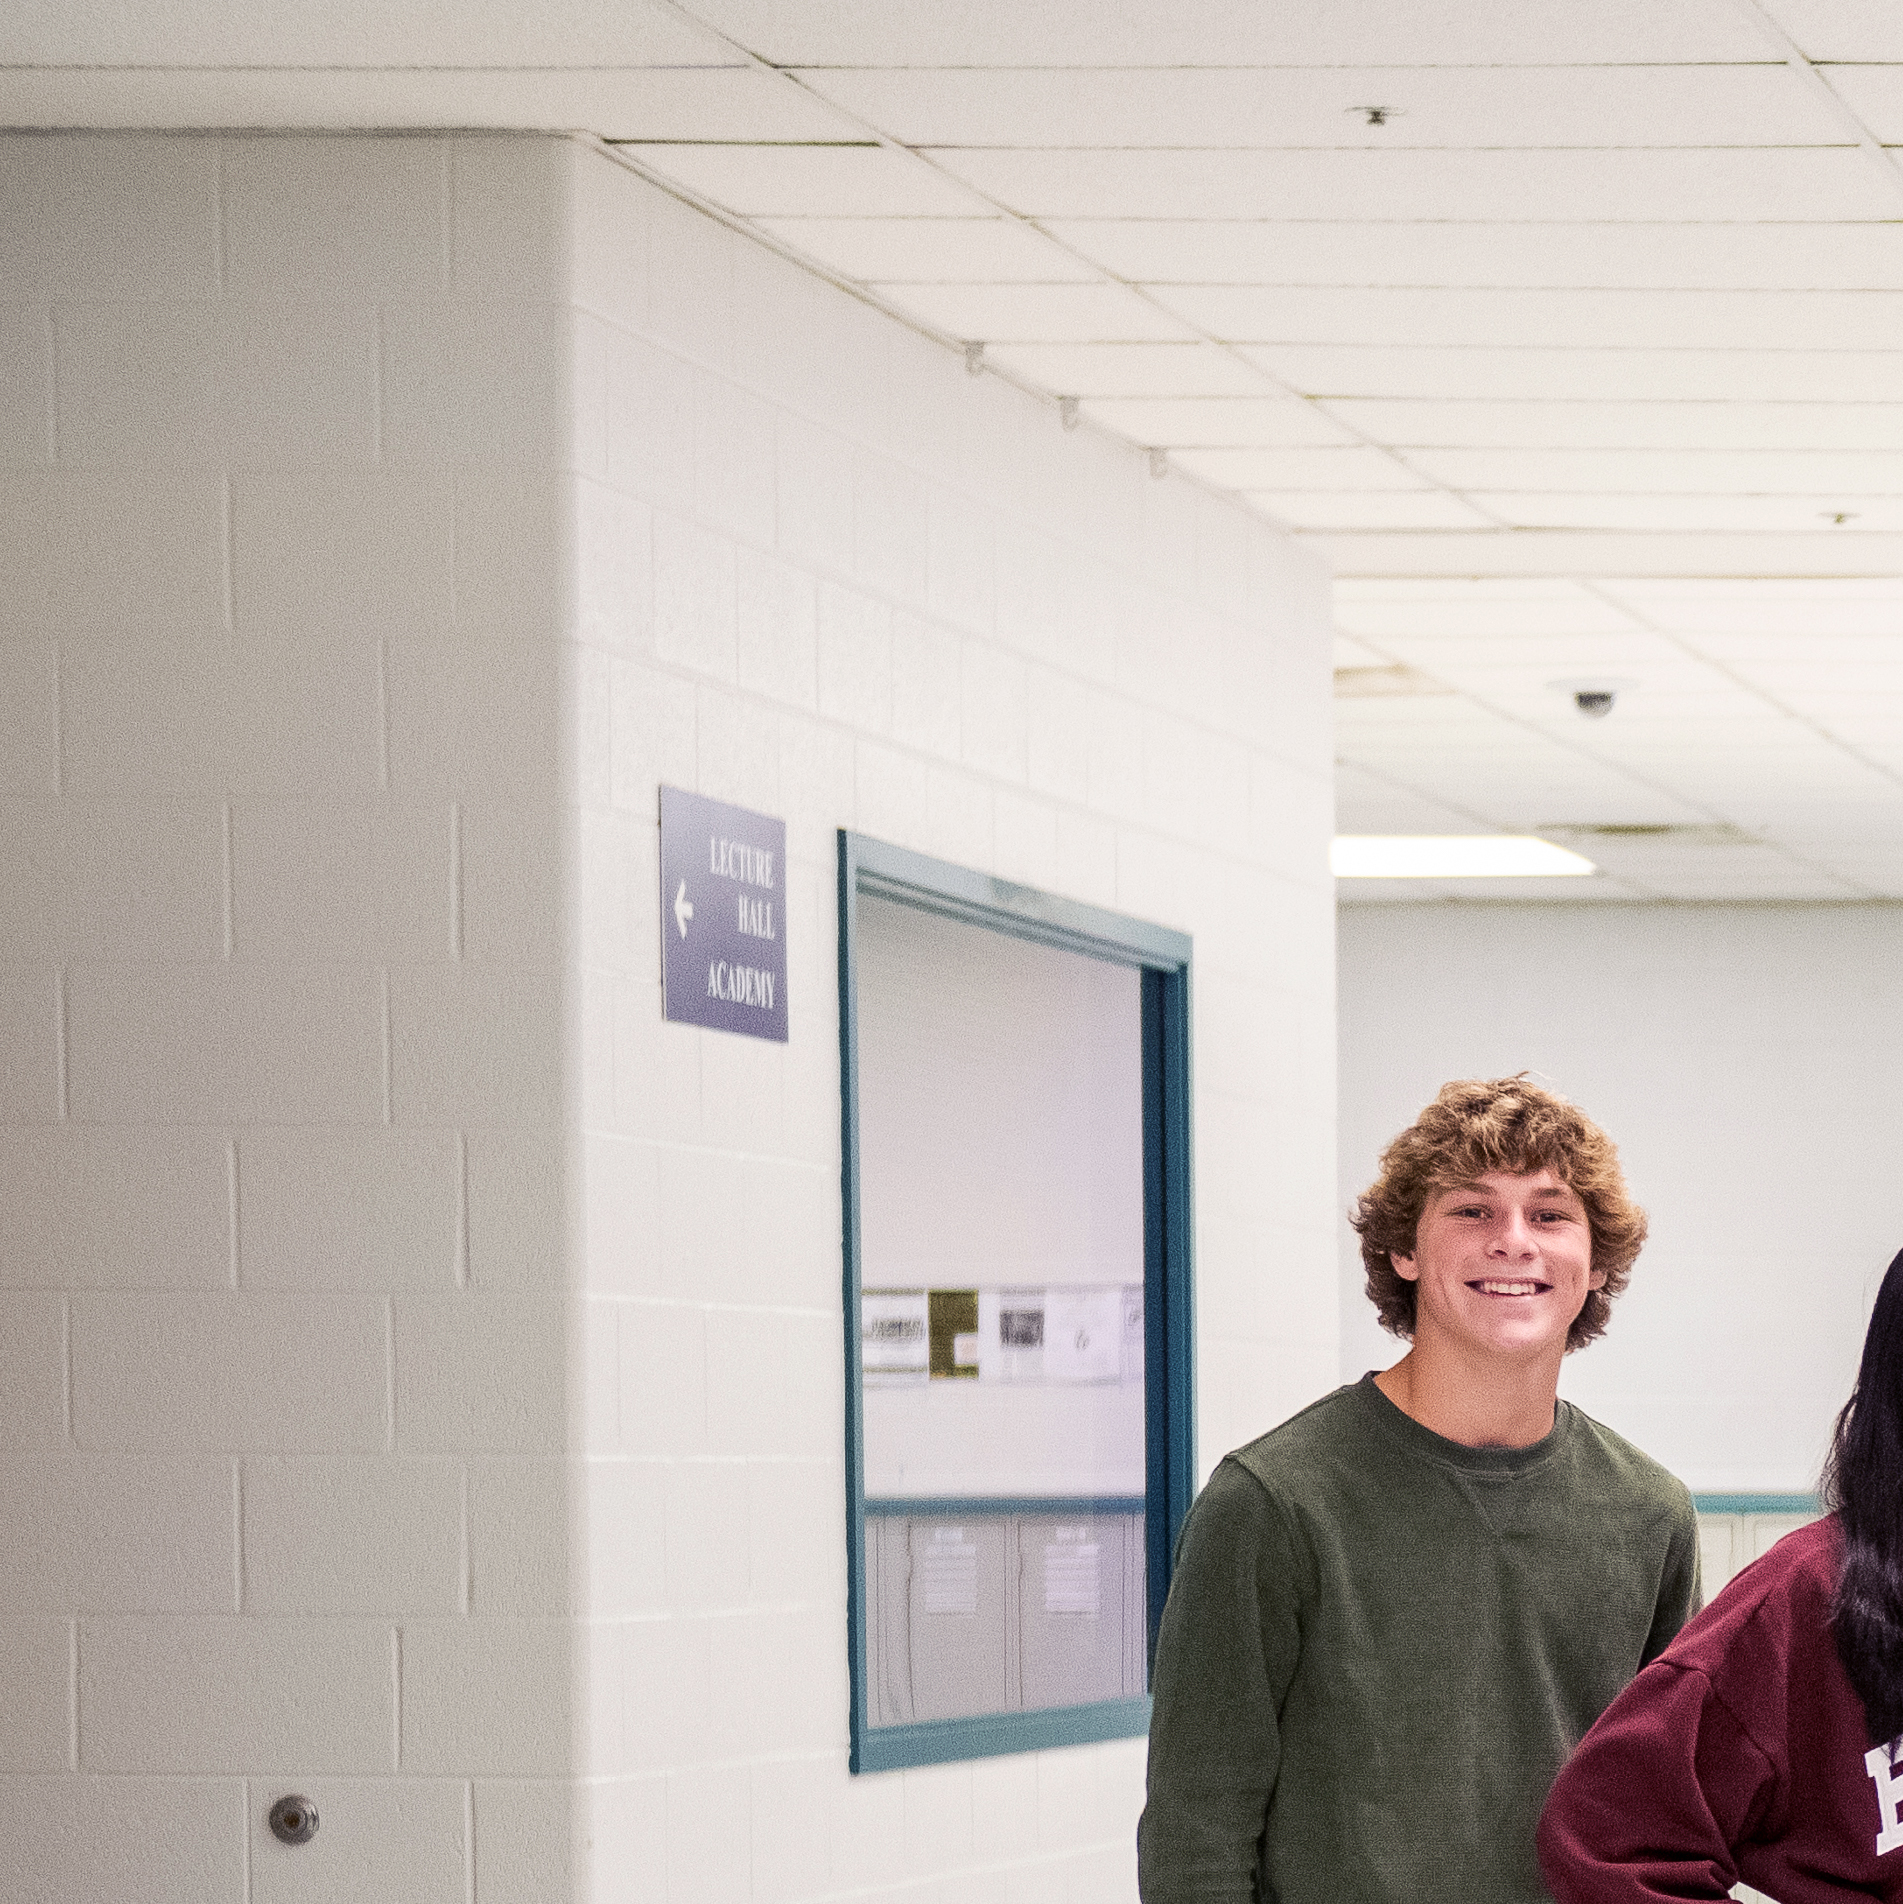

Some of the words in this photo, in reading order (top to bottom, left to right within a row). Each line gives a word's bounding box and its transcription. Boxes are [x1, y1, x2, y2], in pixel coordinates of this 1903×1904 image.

[710, 838, 774, 889] LECTURE
[738, 892, 775, 940] HALL
[707, 959, 775, 1009] ACADEMY
